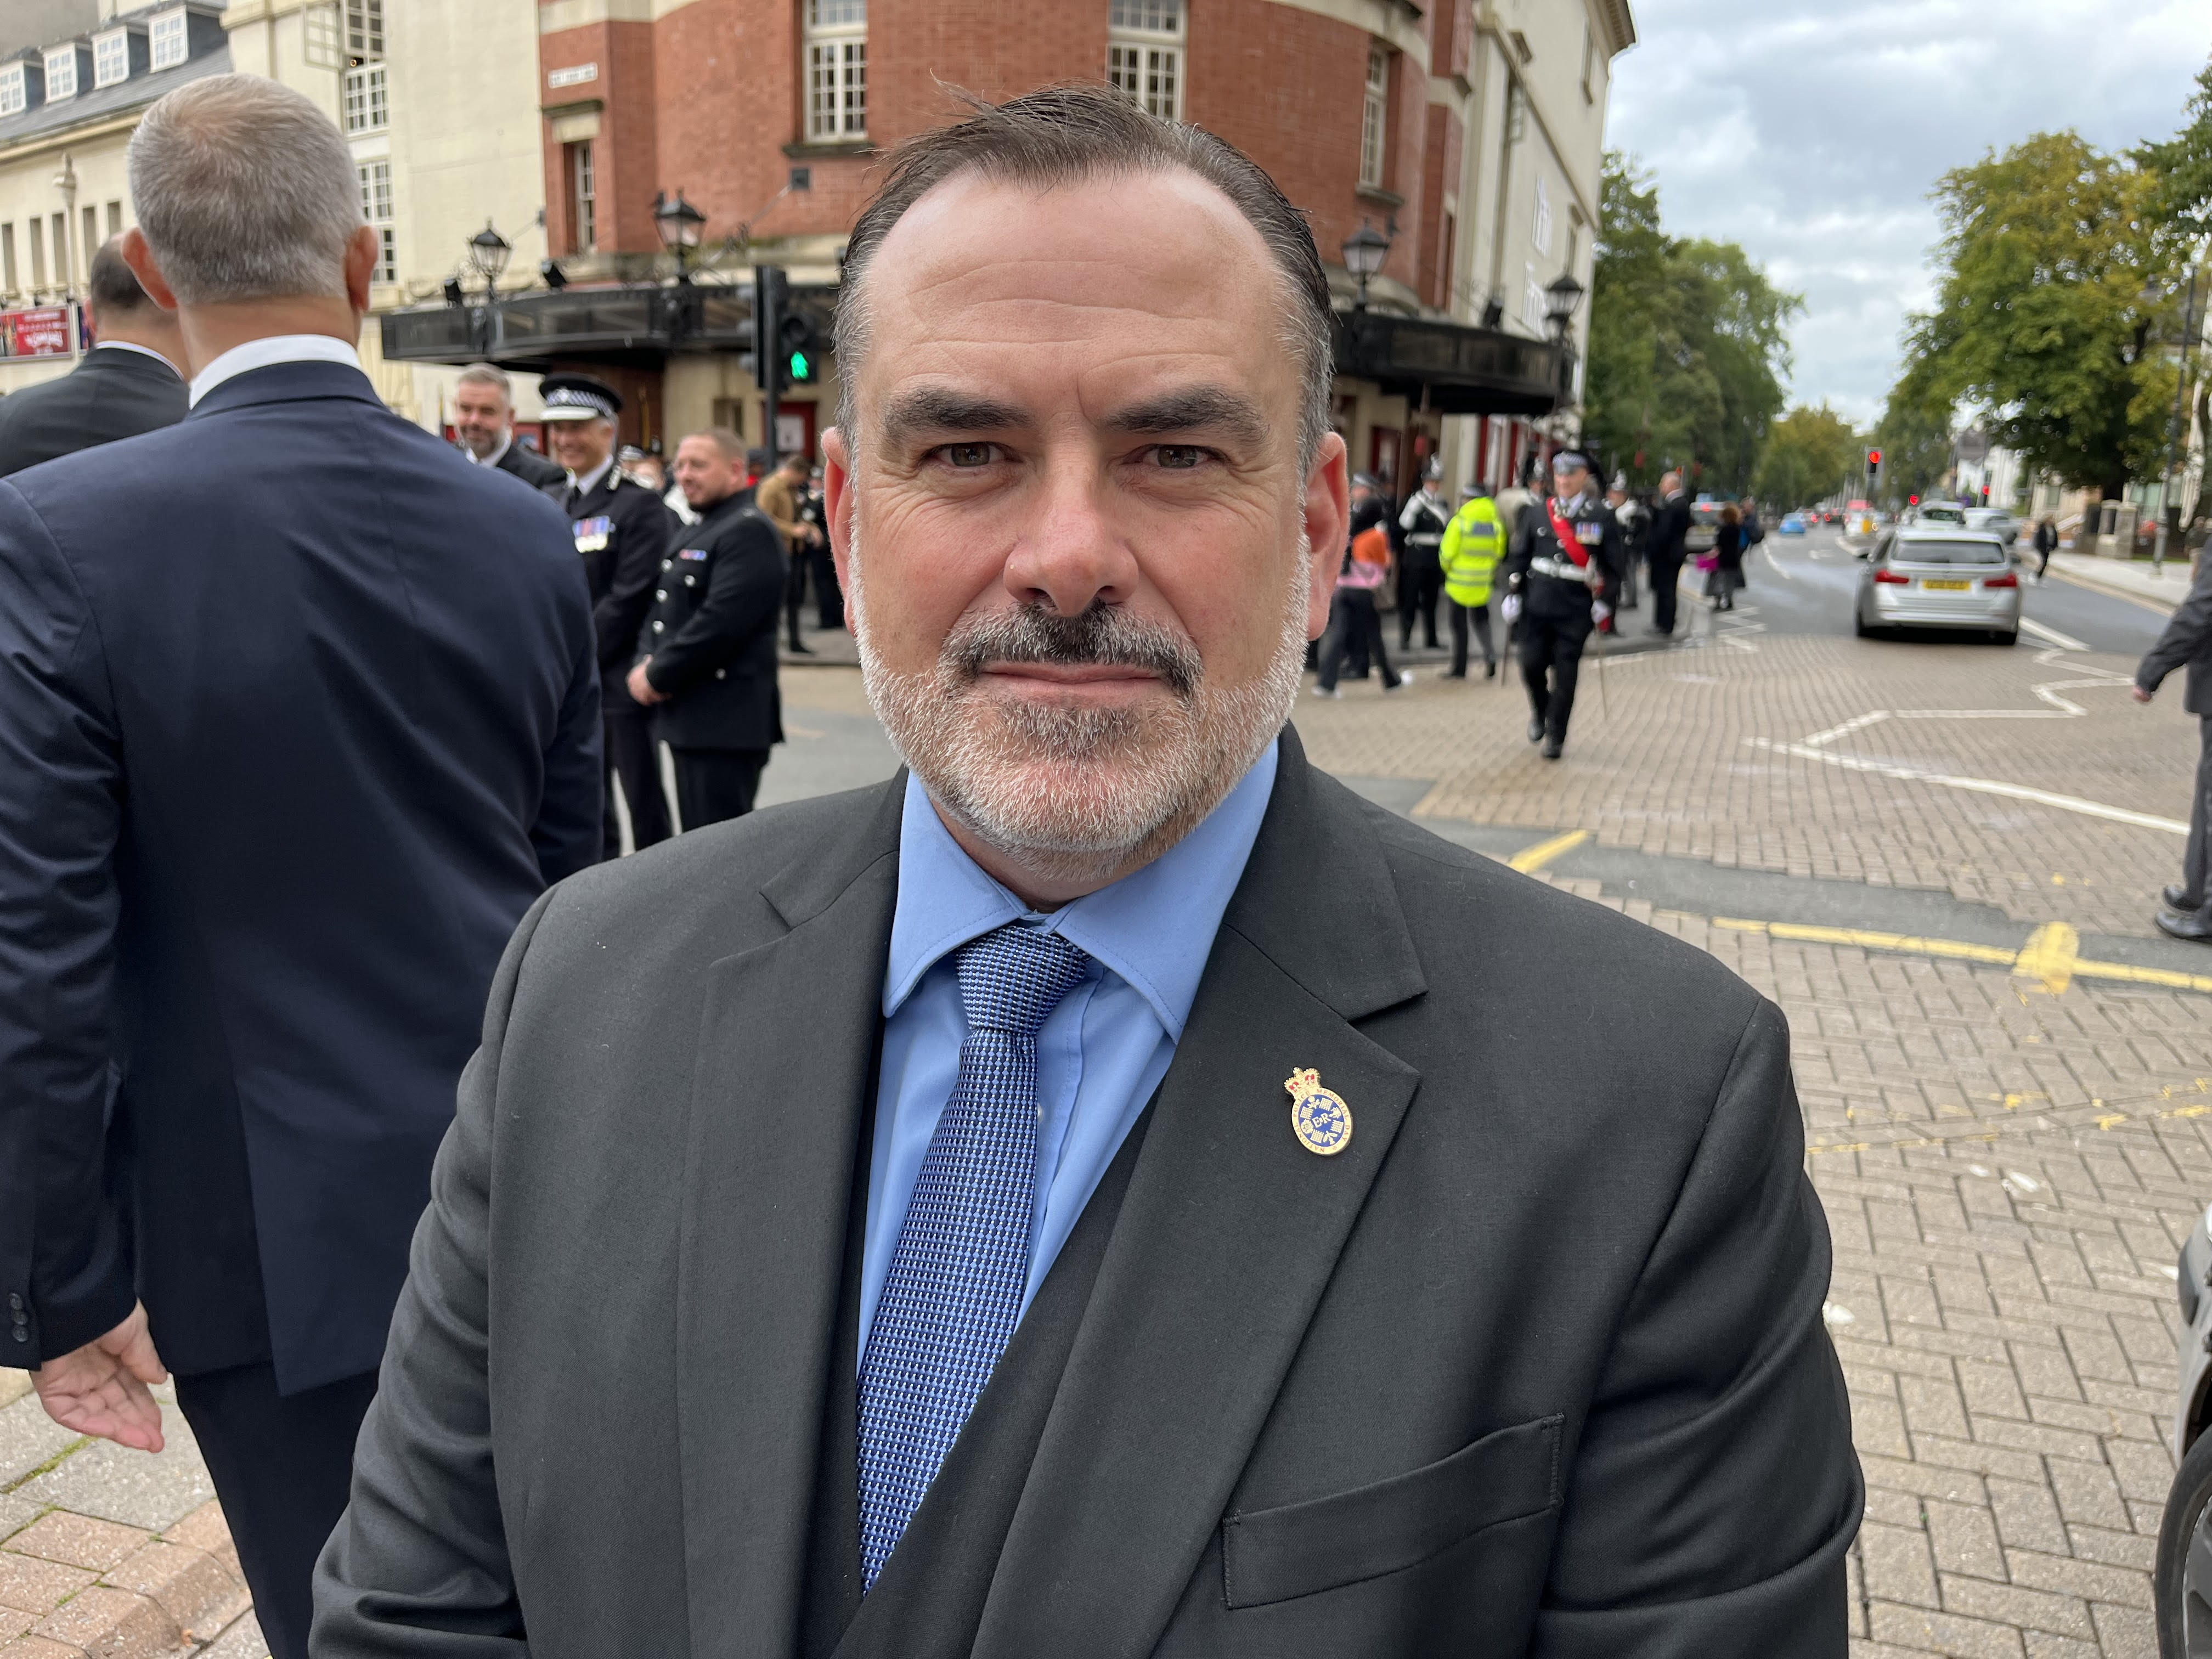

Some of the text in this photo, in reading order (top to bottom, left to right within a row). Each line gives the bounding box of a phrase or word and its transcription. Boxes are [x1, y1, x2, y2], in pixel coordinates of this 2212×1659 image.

[1293, 1091, 1310, 1117] POLICE
[1317, 1089, 1348, 1119] MEMORIAL
[1294, 1125, 1325, 1152] NATIONAL
